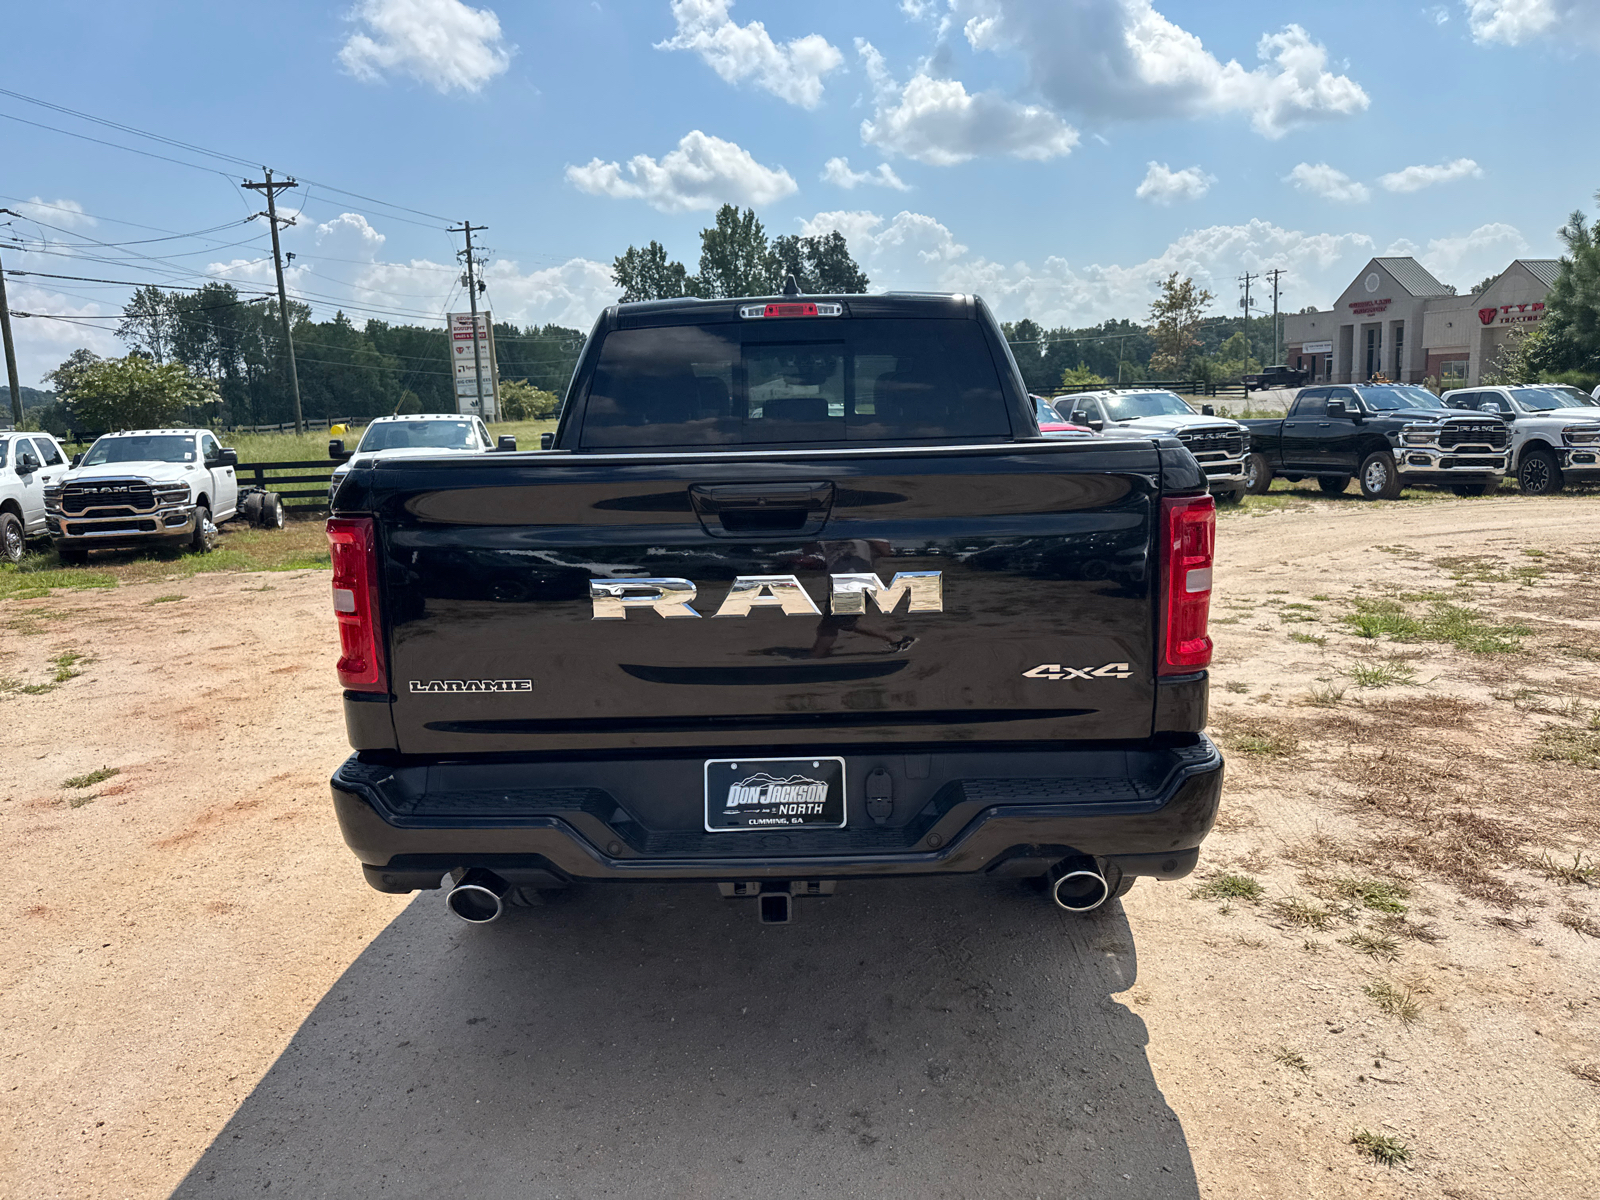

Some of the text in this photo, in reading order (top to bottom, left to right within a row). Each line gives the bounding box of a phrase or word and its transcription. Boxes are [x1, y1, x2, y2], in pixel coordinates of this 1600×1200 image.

[1499, 302, 1545, 314] TYM
[1193, 432, 1227, 440] RAM
[83, 485, 128, 494] RAM
[589, 570, 945, 621] RAM
[1021, 662, 1134, 680] 4x4
[409, 680, 532, 693] LARAMIE
[760, 783, 829, 804] JACKSON
[778, 803, 823, 815] NORTH
